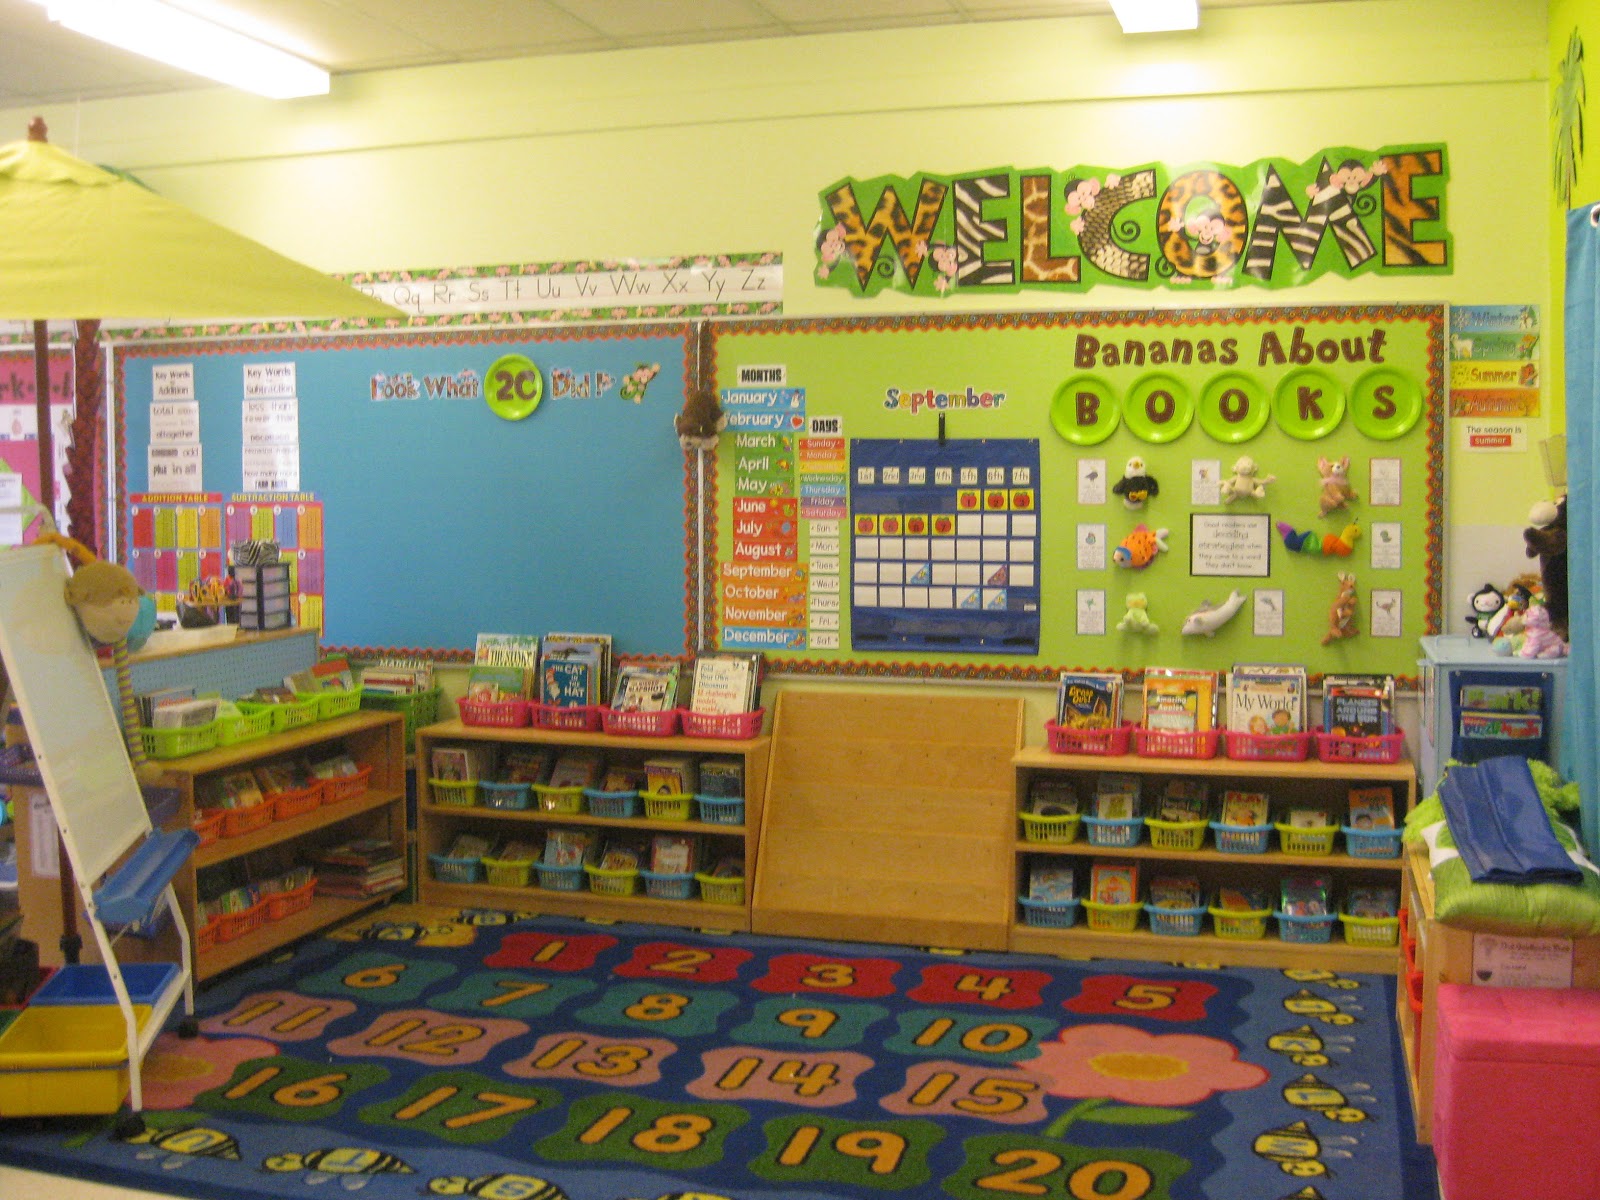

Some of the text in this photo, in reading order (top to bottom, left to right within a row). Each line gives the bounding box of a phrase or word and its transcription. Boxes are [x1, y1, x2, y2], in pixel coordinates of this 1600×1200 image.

[825, 149, 1448, 292] WELCOME
[394, 283, 424, 315] Qq
[433, 283, 455, 305] Rr
[469, 280, 489, 303] Ss
[502, 277, 520, 300] Tt
[537, 276, 561, 299] Uu
[575, 274, 598, 297] Vv
[609, 272, 651, 296] Ww
[662, 270, 689, 294] Xx
[702, 269, 726, 302] Yy
[741, 268, 766, 292] Zz
[1074, 326, 1388, 370] Bananas About
[169, 369, 191, 379] Words
[247, 366, 292, 378] Key Words
[741, 367, 782, 383] MONTHS
[1471, 367, 1518, 384] Summer
[158, 385, 189, 396] Addition
[370, 373, 418, 401] Look
[423, 372, 480, 400] What
[494, 370, 537, 401] 2C
[722, 389, 778, 406] January
[884, 387, 1006, 414] September
[153, 406, 174, 416] total
[723, 413, 785, 429] February
[812, 419, 839, 434] DAYS
[1466, 425, 1522, 435] The season is
[736, 434, 776, 448] March
[807, 439, 836, 450] Sunday
[1475, 436, 1507, 445] summer
[806, 451, 838, 461] Monday
[738, 456, 770, 473] April
[737, 476, 768, 494] May
[803, 473, 843, 483] Wednesday
[805, 484, 841, 495] Thursday
[142, 493, 208, 502] ADDITION TABLE
[231, 493, 314, 502] SUBTRACTION TABLE
[810, 497, 835, 507] Friday
[736, 500, 766, 513] June
[805, 507, 842, 518] Saturday
[736, 519, 763, 539] July
[735, 542, 783, 561] August
[722, 563, 793, 581] September
[725, 583, 780, 598] October
[725, 606, 788, 622] November
[724, 628, 791, 644] December
[552, 664, 584, 676] THE CAT
[569, 680, 580, 688] THE
[564, 686, 585, 698] HAT
[1156, 695, 1187, 705] Amazing
[1235, 693, 1295, 712] My World
[533, 940, 1180, 1011] 1 2 3 4 5
[342, 964, 1034, 1054] 6 7 8 9 10
[227, 1000, 1049, 1115] 11 12 13 14 15
[222, 1066, 1153, 1200] 16 17 18 19 20
